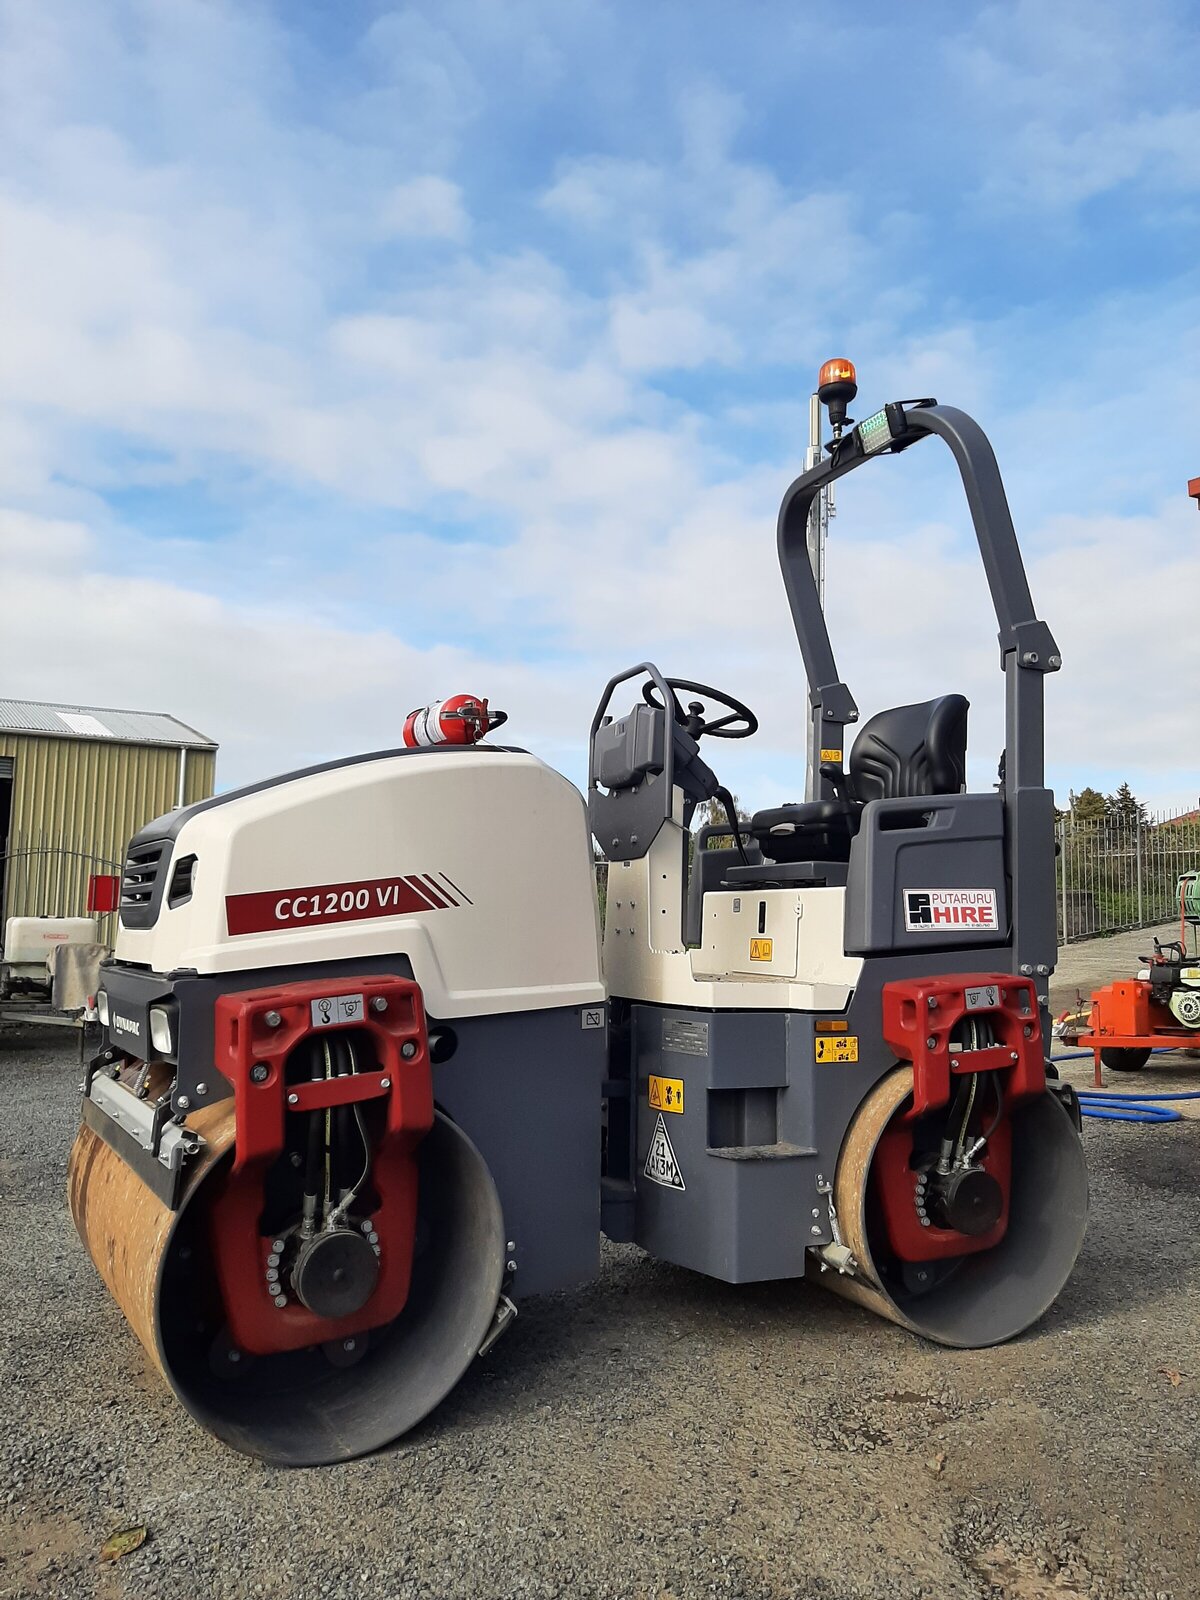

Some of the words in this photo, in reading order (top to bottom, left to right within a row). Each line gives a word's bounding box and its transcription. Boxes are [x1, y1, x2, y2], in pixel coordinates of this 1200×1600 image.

[274, 889, 370, 920] CC1200
[376, 885, 399, 907] VI
[932, 893, 992, 905] PUTARURU
[933, 906, 994, 924] HIRE
[656, 1140, 666, 1158] 21
